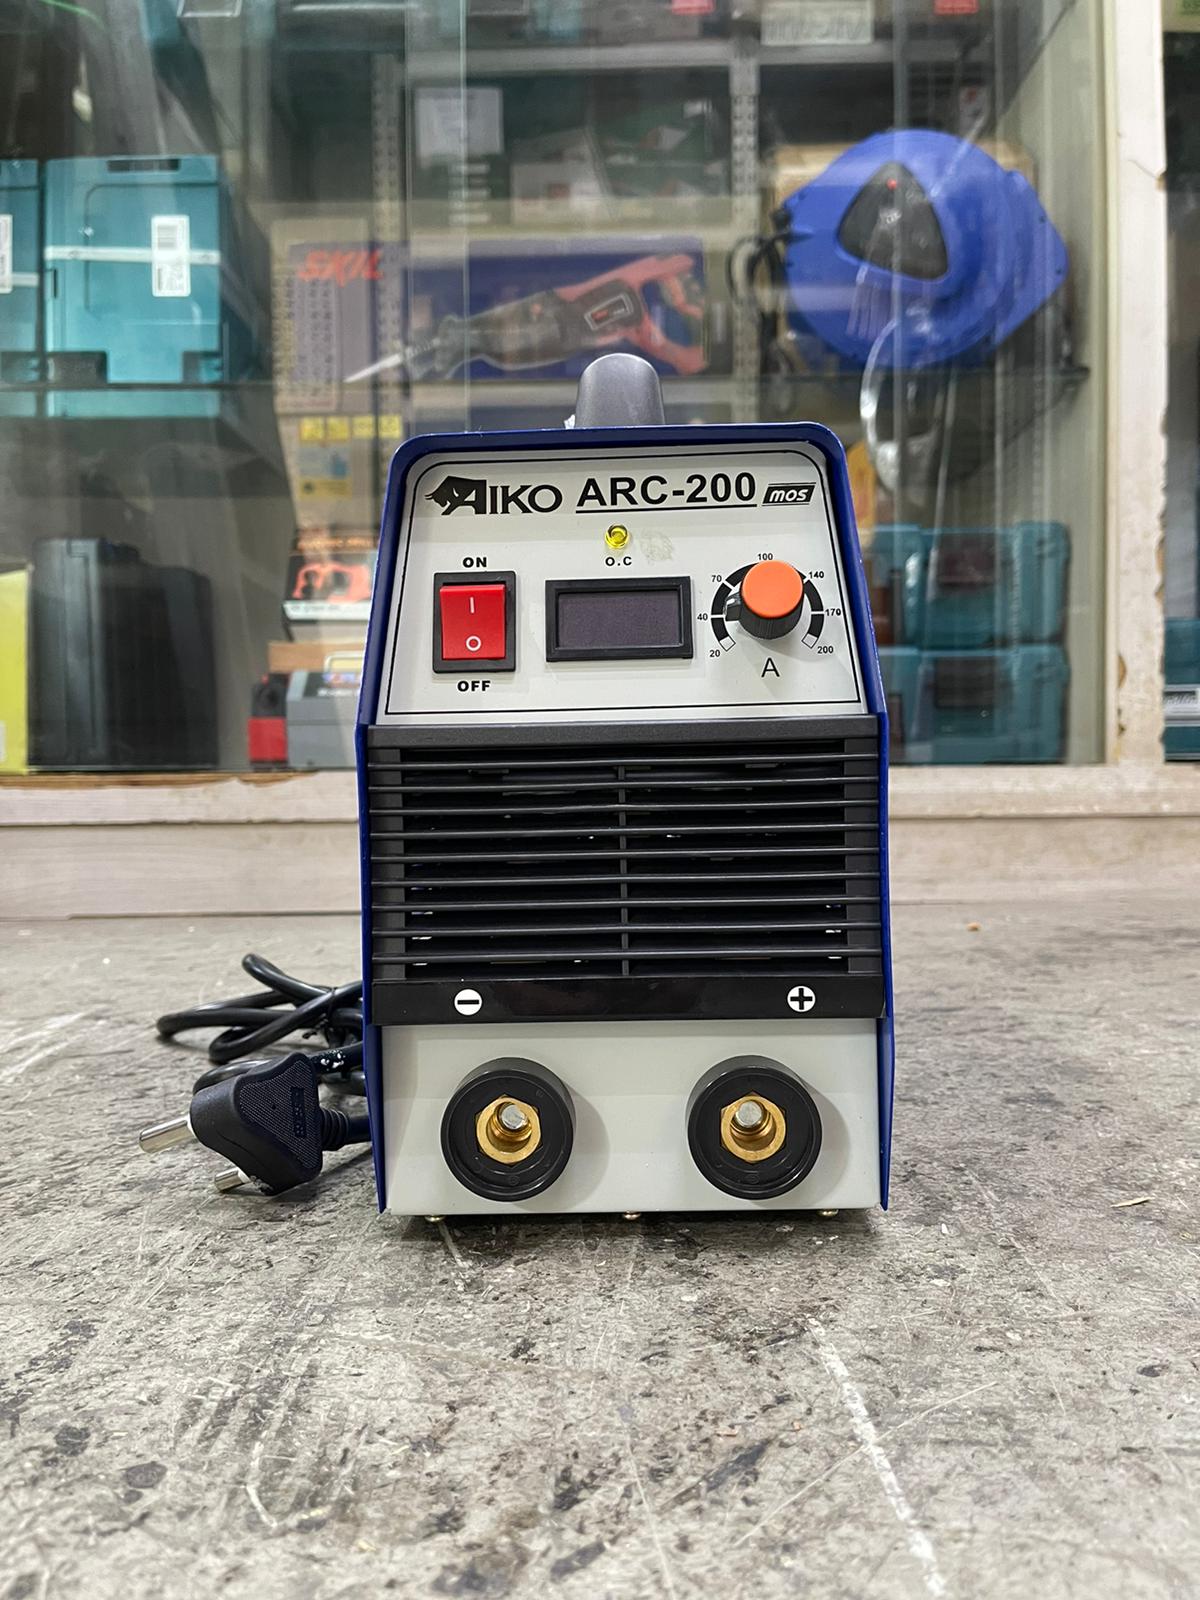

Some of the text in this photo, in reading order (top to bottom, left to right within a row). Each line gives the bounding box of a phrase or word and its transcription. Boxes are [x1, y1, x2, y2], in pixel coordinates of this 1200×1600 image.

[297, 249, 384, 287] SKIL
[429, 476, 563, 516] AIKO
[576, 472, 756, 508] ARC-200
[604, 556, 633, 567] O.C
[758, 552, 774, 561] 100
[462, 556, 488, 569] ON
[711, 574, 722, 583] 70
[808, 571, 825, 580] 140
[697, 613, 708, 621] 40
[825, 608, 842, 617] 170
[709, 649, 721, 658] 20
[817, 645, 834, 655] 200
[761, 657, 780, 678] A
[457, 680, 491, 693] OFF
